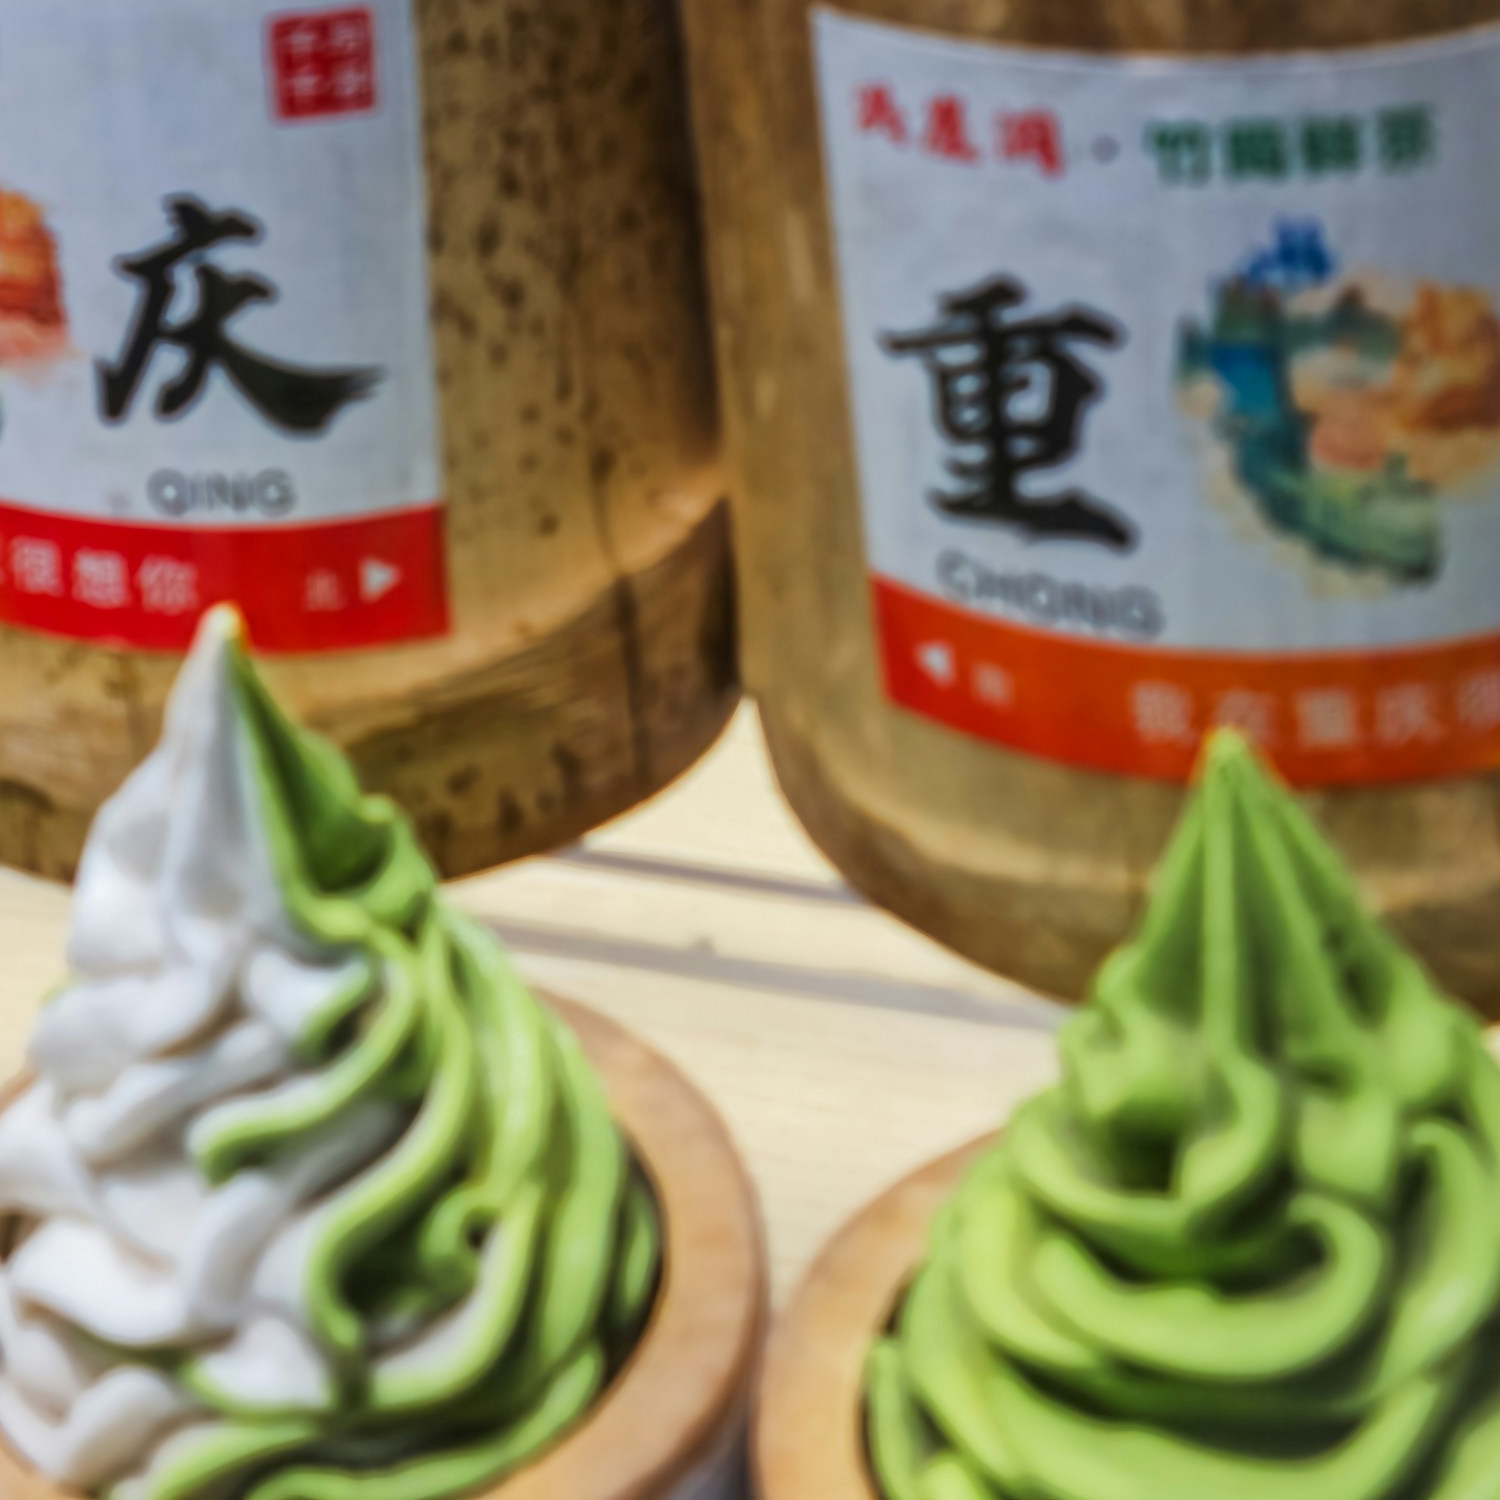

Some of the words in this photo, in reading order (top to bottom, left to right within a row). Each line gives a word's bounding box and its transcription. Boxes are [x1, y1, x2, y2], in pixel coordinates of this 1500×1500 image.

[93, 191, 391, 440] 庆
[147, 470, 299, 520] QING
[877, 275, 1138, 552] 重
[936, 552, 1168, 644] CHONG
